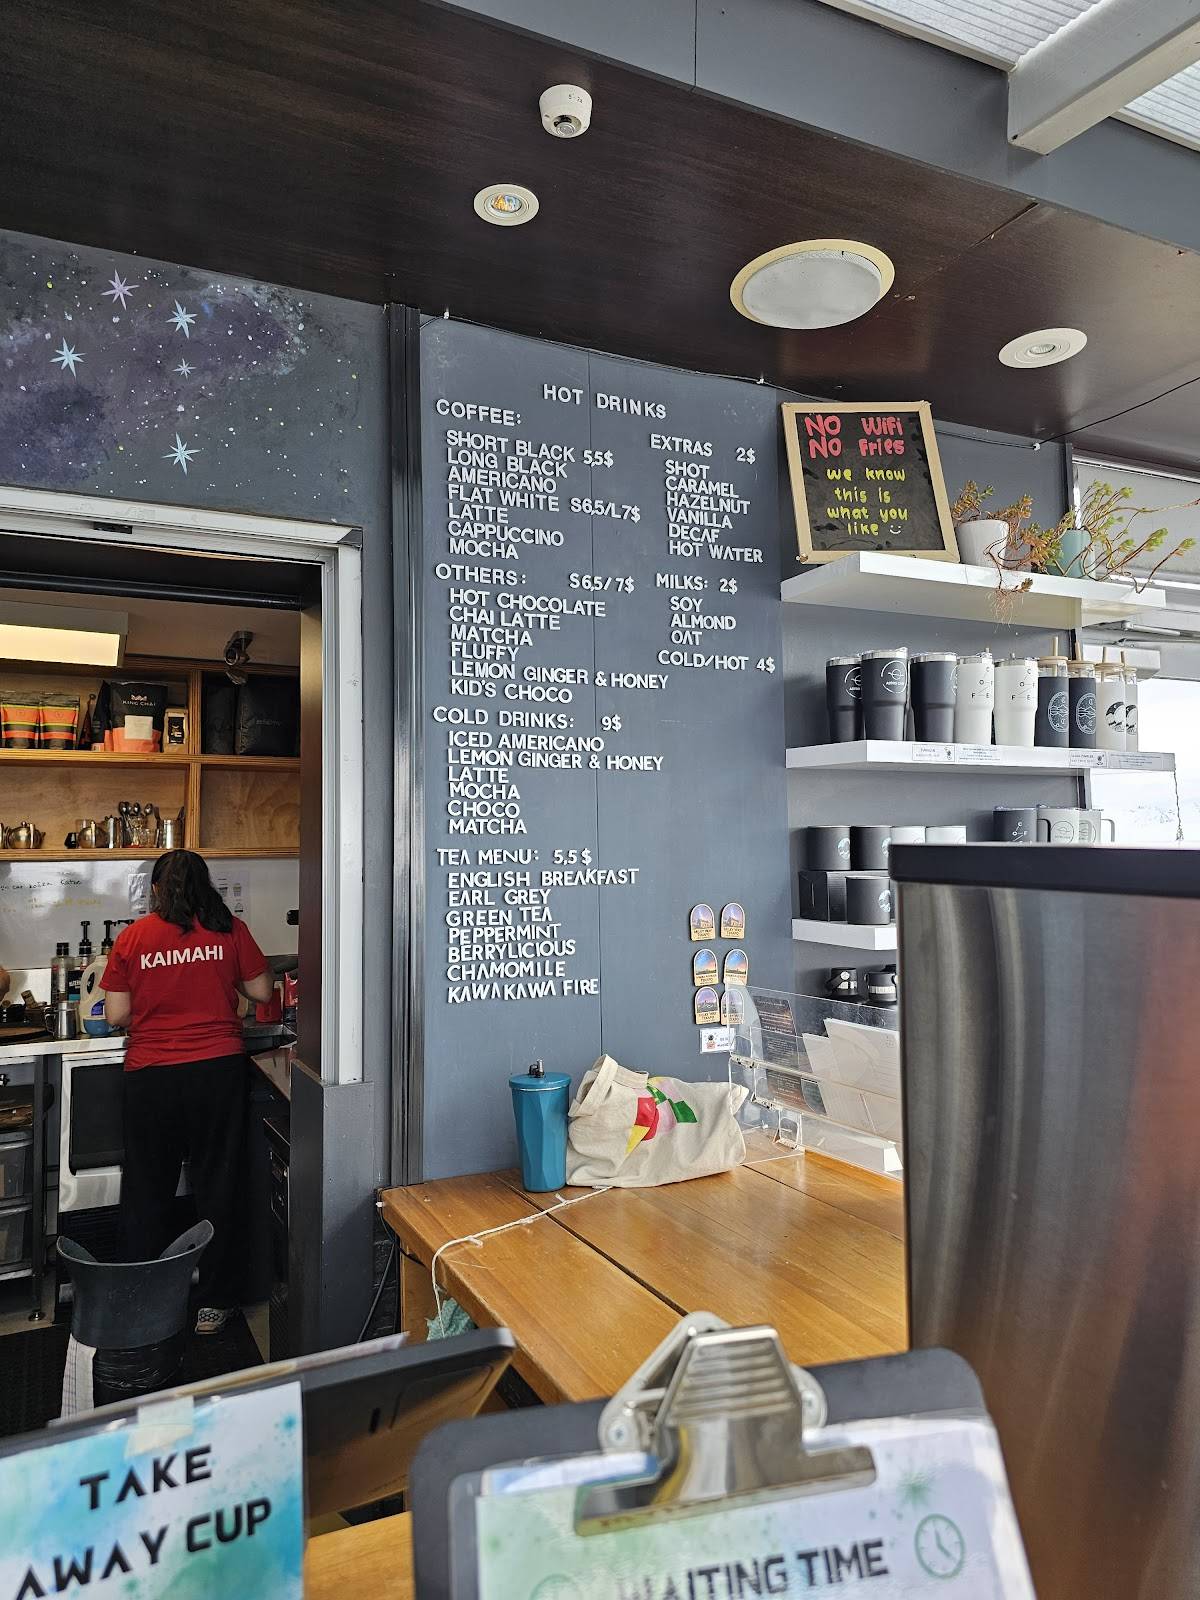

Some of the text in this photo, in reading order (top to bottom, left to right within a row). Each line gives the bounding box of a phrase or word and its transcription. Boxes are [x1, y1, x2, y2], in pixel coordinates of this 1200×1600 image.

[436, 399, 522, 426] COFFEE:
[543, 384, 667, 419] HOT DRINKS
[804, 415, 841, 436] NO
[447, 430, 508, 453] SHORT
[516, 440, 575, 463] BLACK
[650, 434, 756, 464] EXTRAS 2$
[809, 436, 842, 458] NO
[447, 448, 567, 478] LONG BLACK
[665, 460, 709, 479] SHOT
[448, 466, 557, 494] AMERICANO
[827, 468, 905, 481] we know
[448, 484, 493, 504] FLAT
[500, 490, 559, 512] WHITE
[666, 476, 739, 498] CARAMEL
[835, 486, 891, 503] this is
[448, 503, 508, 524] LATTE
[667, 491, 750, 514] HAZELNUT
[667, 507, 732, 529] VANILLA
[827, 506, 908, 522] what you
[448, 521, 564, 546] CAPPUCCINO
[668, 523, 719, 543] DECAF
[847, 522, 879, 536] like
[449, 538, 519, 560] MOCHA
[669, 540, 763, 563] HOT WATER
[435, 563, 526, 585] OTHERS:
[656, 573, 738, 595] MILKS: 2$
[450, 588, 606, 617] HOT CHOCOLATE
[671, 596, 702, 612] SOY
[450, 605, 560, 631] CHAI LATTE
[671, 615, 736, 630] ALMOND
[451, 624, 533, 646] MATCHA
[671, 631, 702, 646] OAT
[451, 642, 519, 662] FLUFFY
[658, 650, 775, 674] COLD/HOT 4$
[451, 660, 668, 690] LEMON GINGER & HONEY
[451, 678, 572, 703] KID'S CHOCO
[433, 706, 622, 732] COLD DRINKS: 9$
[449, 731, 605, 752] ICED AMERICANO
[448, 749, 663, 771] LEMON GINGER & HONEY
[448, 767, 508, 784] LATTE
[450, 783, 520, 800] MOCHA
[447, 800, 519, 819] CHOCO
[449, 819, 527, 834] MATCHA
[437, 849, 469, 865] TEA
[478, 849, 539, 865] MENU:
[449, 868, 639, 888] ENGLISH BREAKFAST
[449, 889, 551, 907] EARL GREY
[446, 907, 552, 927] GREEN TEA
[449, 923, 561, 944] PEPPERMINT
[140, 945, 223, 970] KAIMAHI
[448, 940, 576, 963] BERRYLICIOUS
[447, 961, 565, 981] CHAMOMILE
[563, 979, 599, 996] FIRE
[79, 1443, 212, 1511] TAKE
[16, 1497, 272, 1600] AWAY CUP
[797, 1537, 889, 1587] TIME
